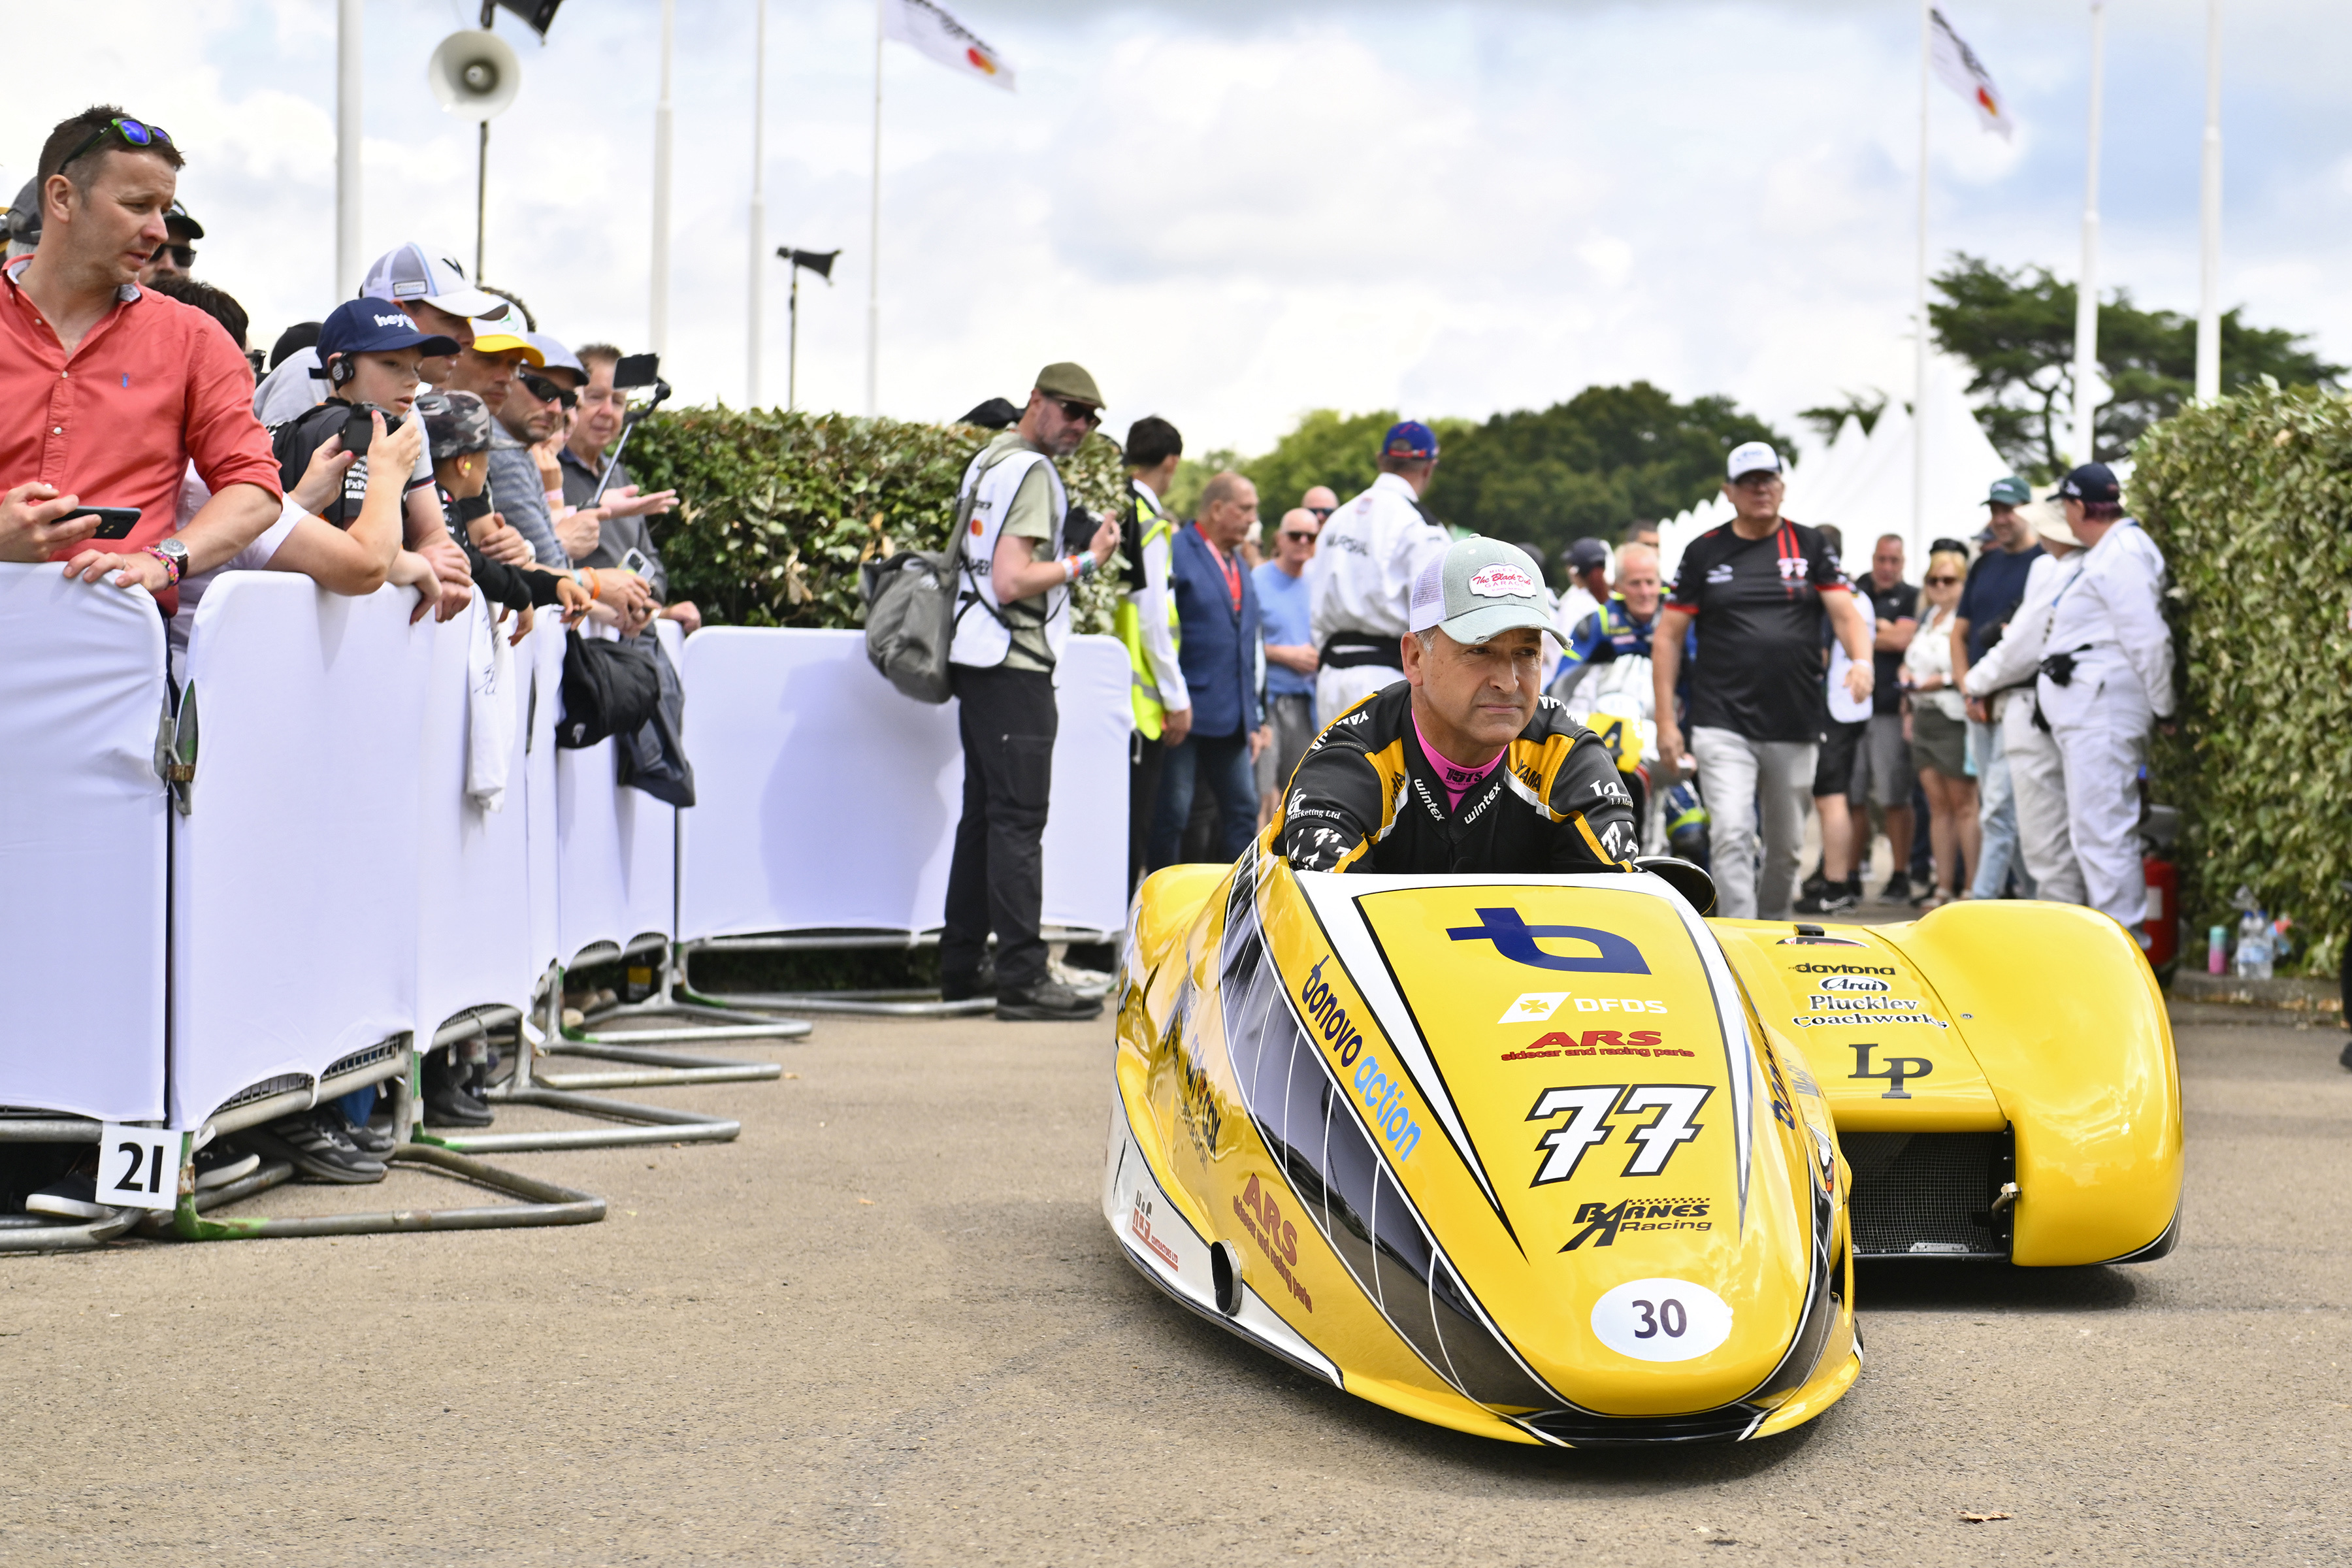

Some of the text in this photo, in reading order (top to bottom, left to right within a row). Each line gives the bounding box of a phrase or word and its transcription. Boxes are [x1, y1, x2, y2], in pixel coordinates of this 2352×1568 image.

[1473, 576, 1490, 585] The
[1326, 810, 1341, 819] Ltd
[1414, 779, 1445, 821] wintex
[1464, 782, 1501, 825] wintex
[1796, 962, 1896, 975] daytona
[1830, 980, 1878, 991] Arai
[1574, 998, 1668, 1014] DFDS
[1301, 954, 1421, 1162] bonovo action
[1501, 1047, 1695, 1061] sidecar and racing parts
[1526, 1030, 1662, 1049] ARS
[1848, 1043, 1933, 1100] LP
[1524, 1084, 1717, 1189] 77
[114, 1141, 164, 1193] 21
[1243, 1172, 1297, 1266] ARS
[1620, 1220, 1712, 1232] Racing
[1257, 1228, 1269, 1259] and
[1270, 1246, 1292, 1293] racing
[1632, 1298, 1687, 1339] 30
